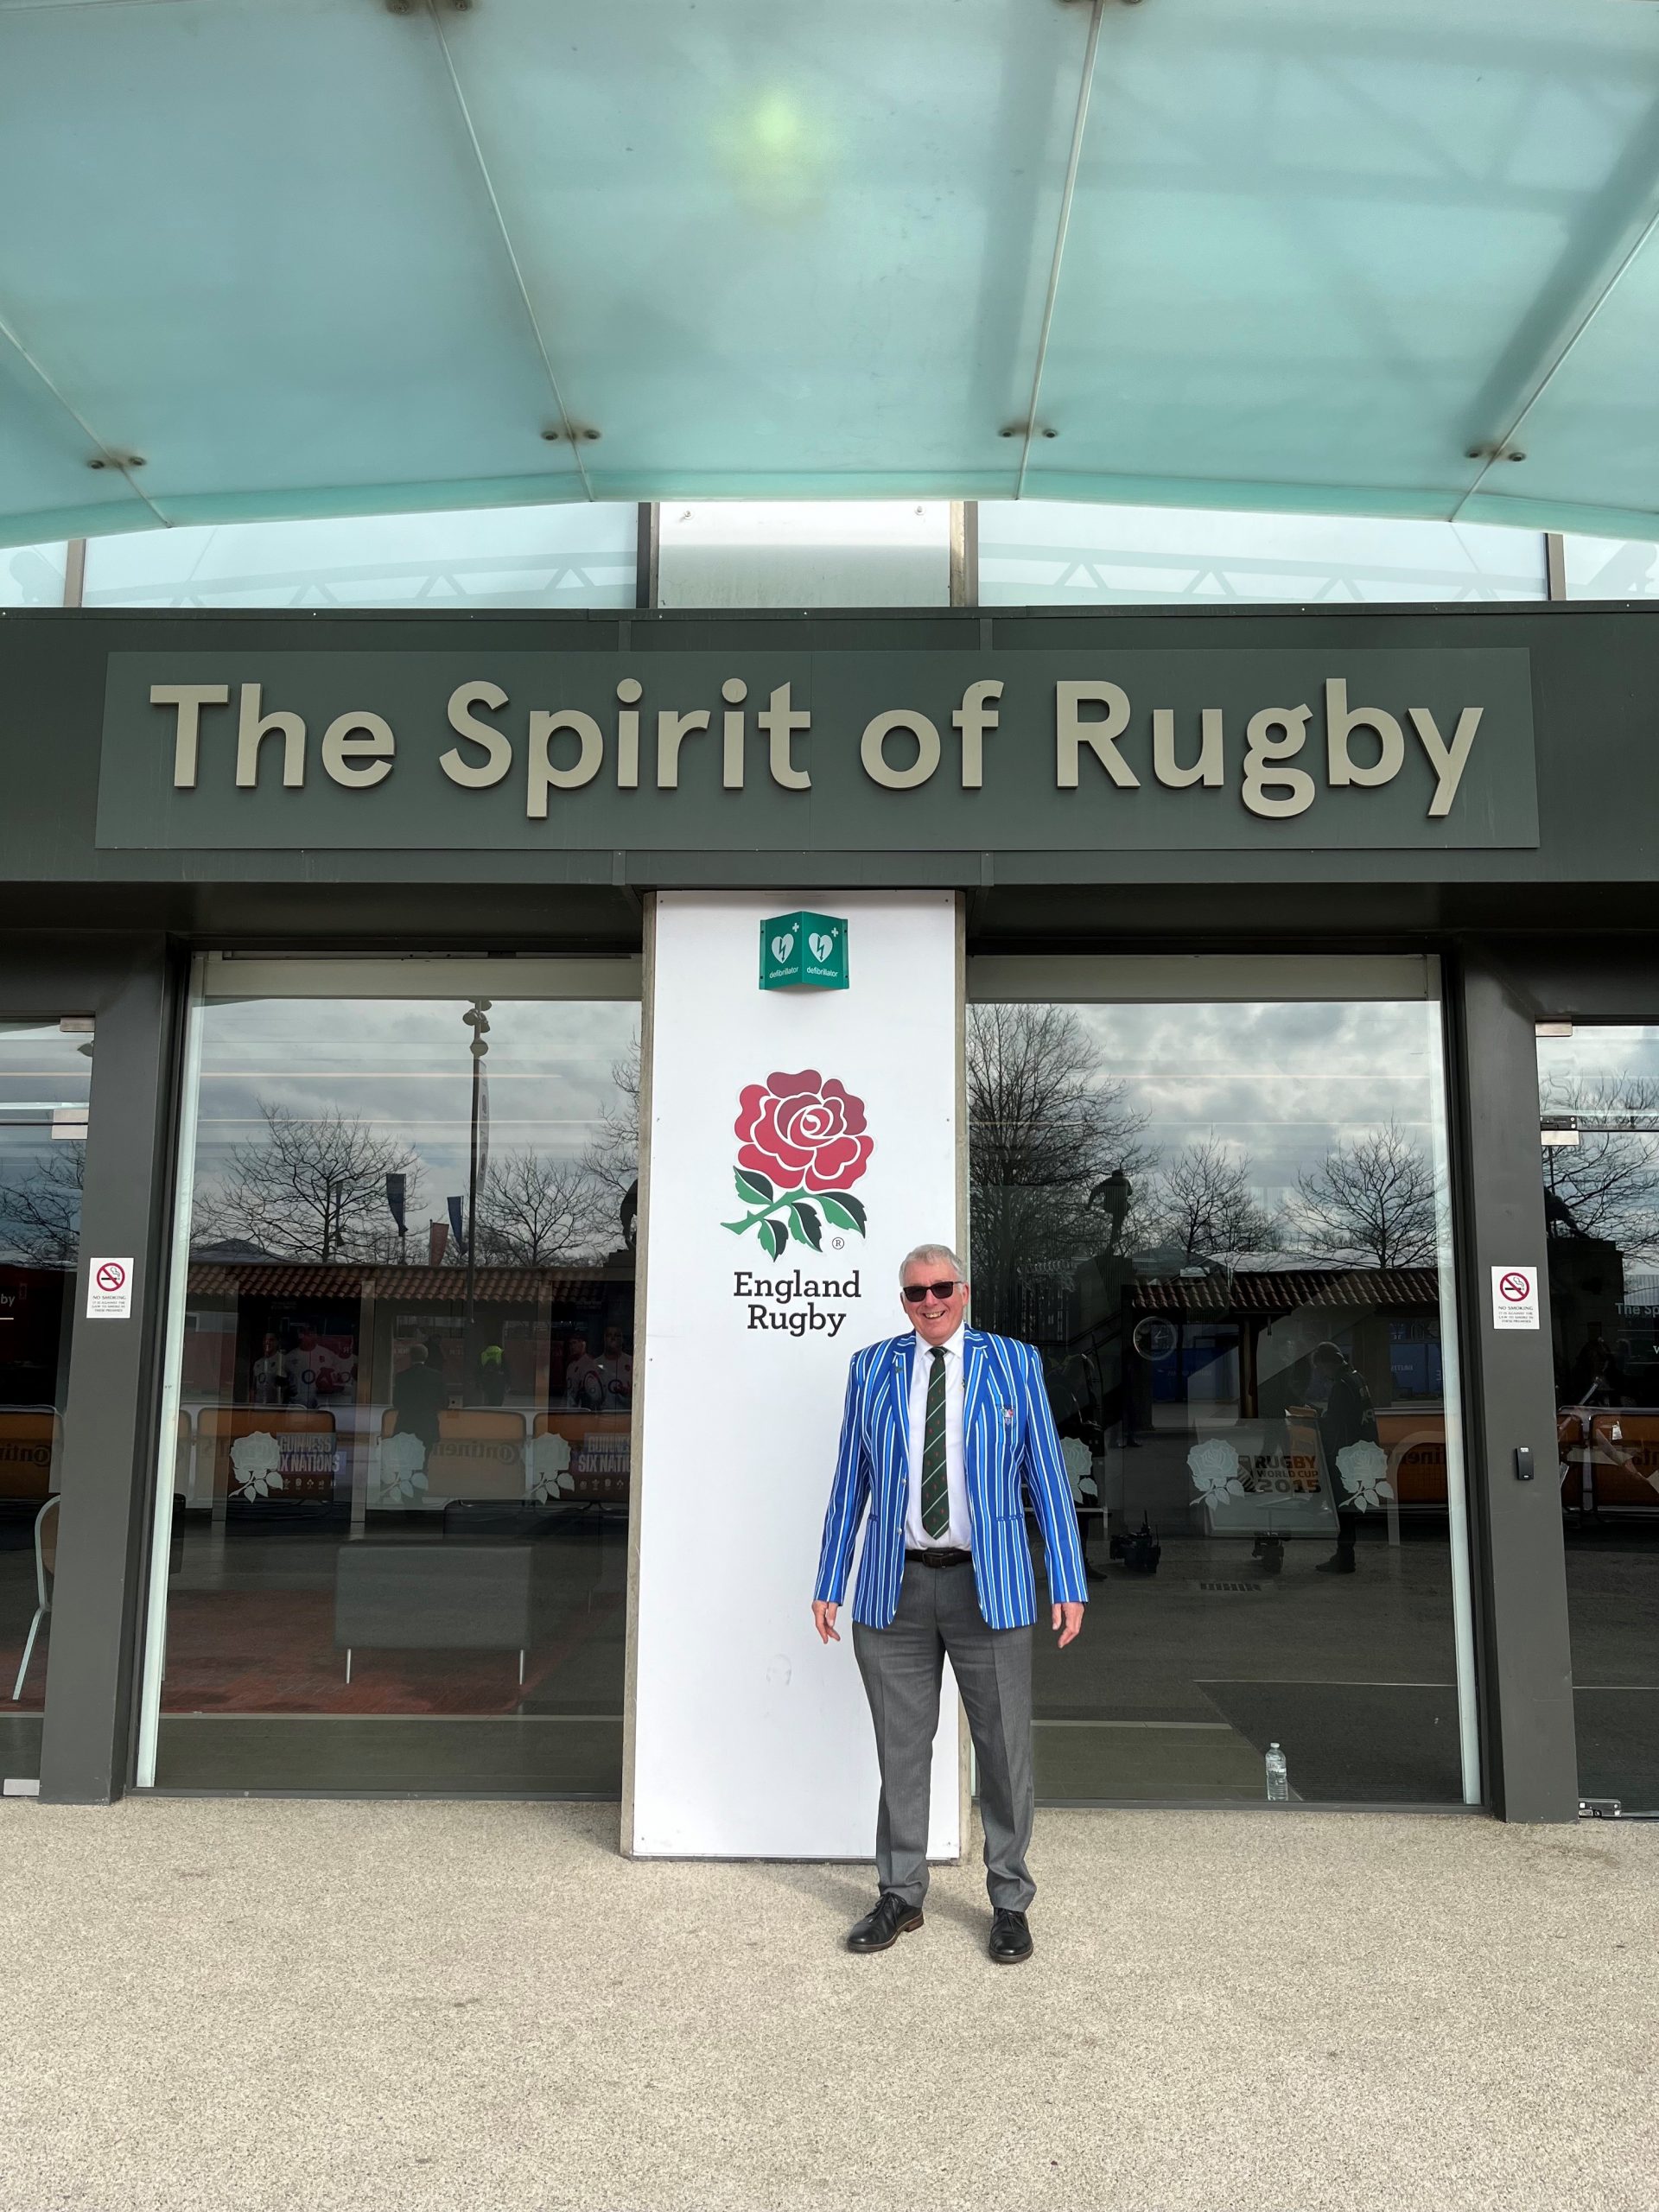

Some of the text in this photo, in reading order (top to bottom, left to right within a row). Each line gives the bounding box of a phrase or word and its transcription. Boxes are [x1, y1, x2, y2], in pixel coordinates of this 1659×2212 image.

[149, 677, 1485, 819] The Spirit of Rugby
[769, 965, 799, 979] defibrillator
[806, 965, 838, 978] defibrillator
[734, 1269, 861, 1304] England
[1614, 1302, 1641, 1315] The
[747, 1302, 847, 1337] Rugby
[279, 1435, 332, 1452] GUINNESS
[588, 1435, 631, 1452] GUINNES
[290, 1453, 340, 1472] NATIONS
[578, 1453, 597, 1472] SIX
[1255, 1455, 1316, 1469] RUGBY
[1257, 1478, 1322, 1493] 2015
